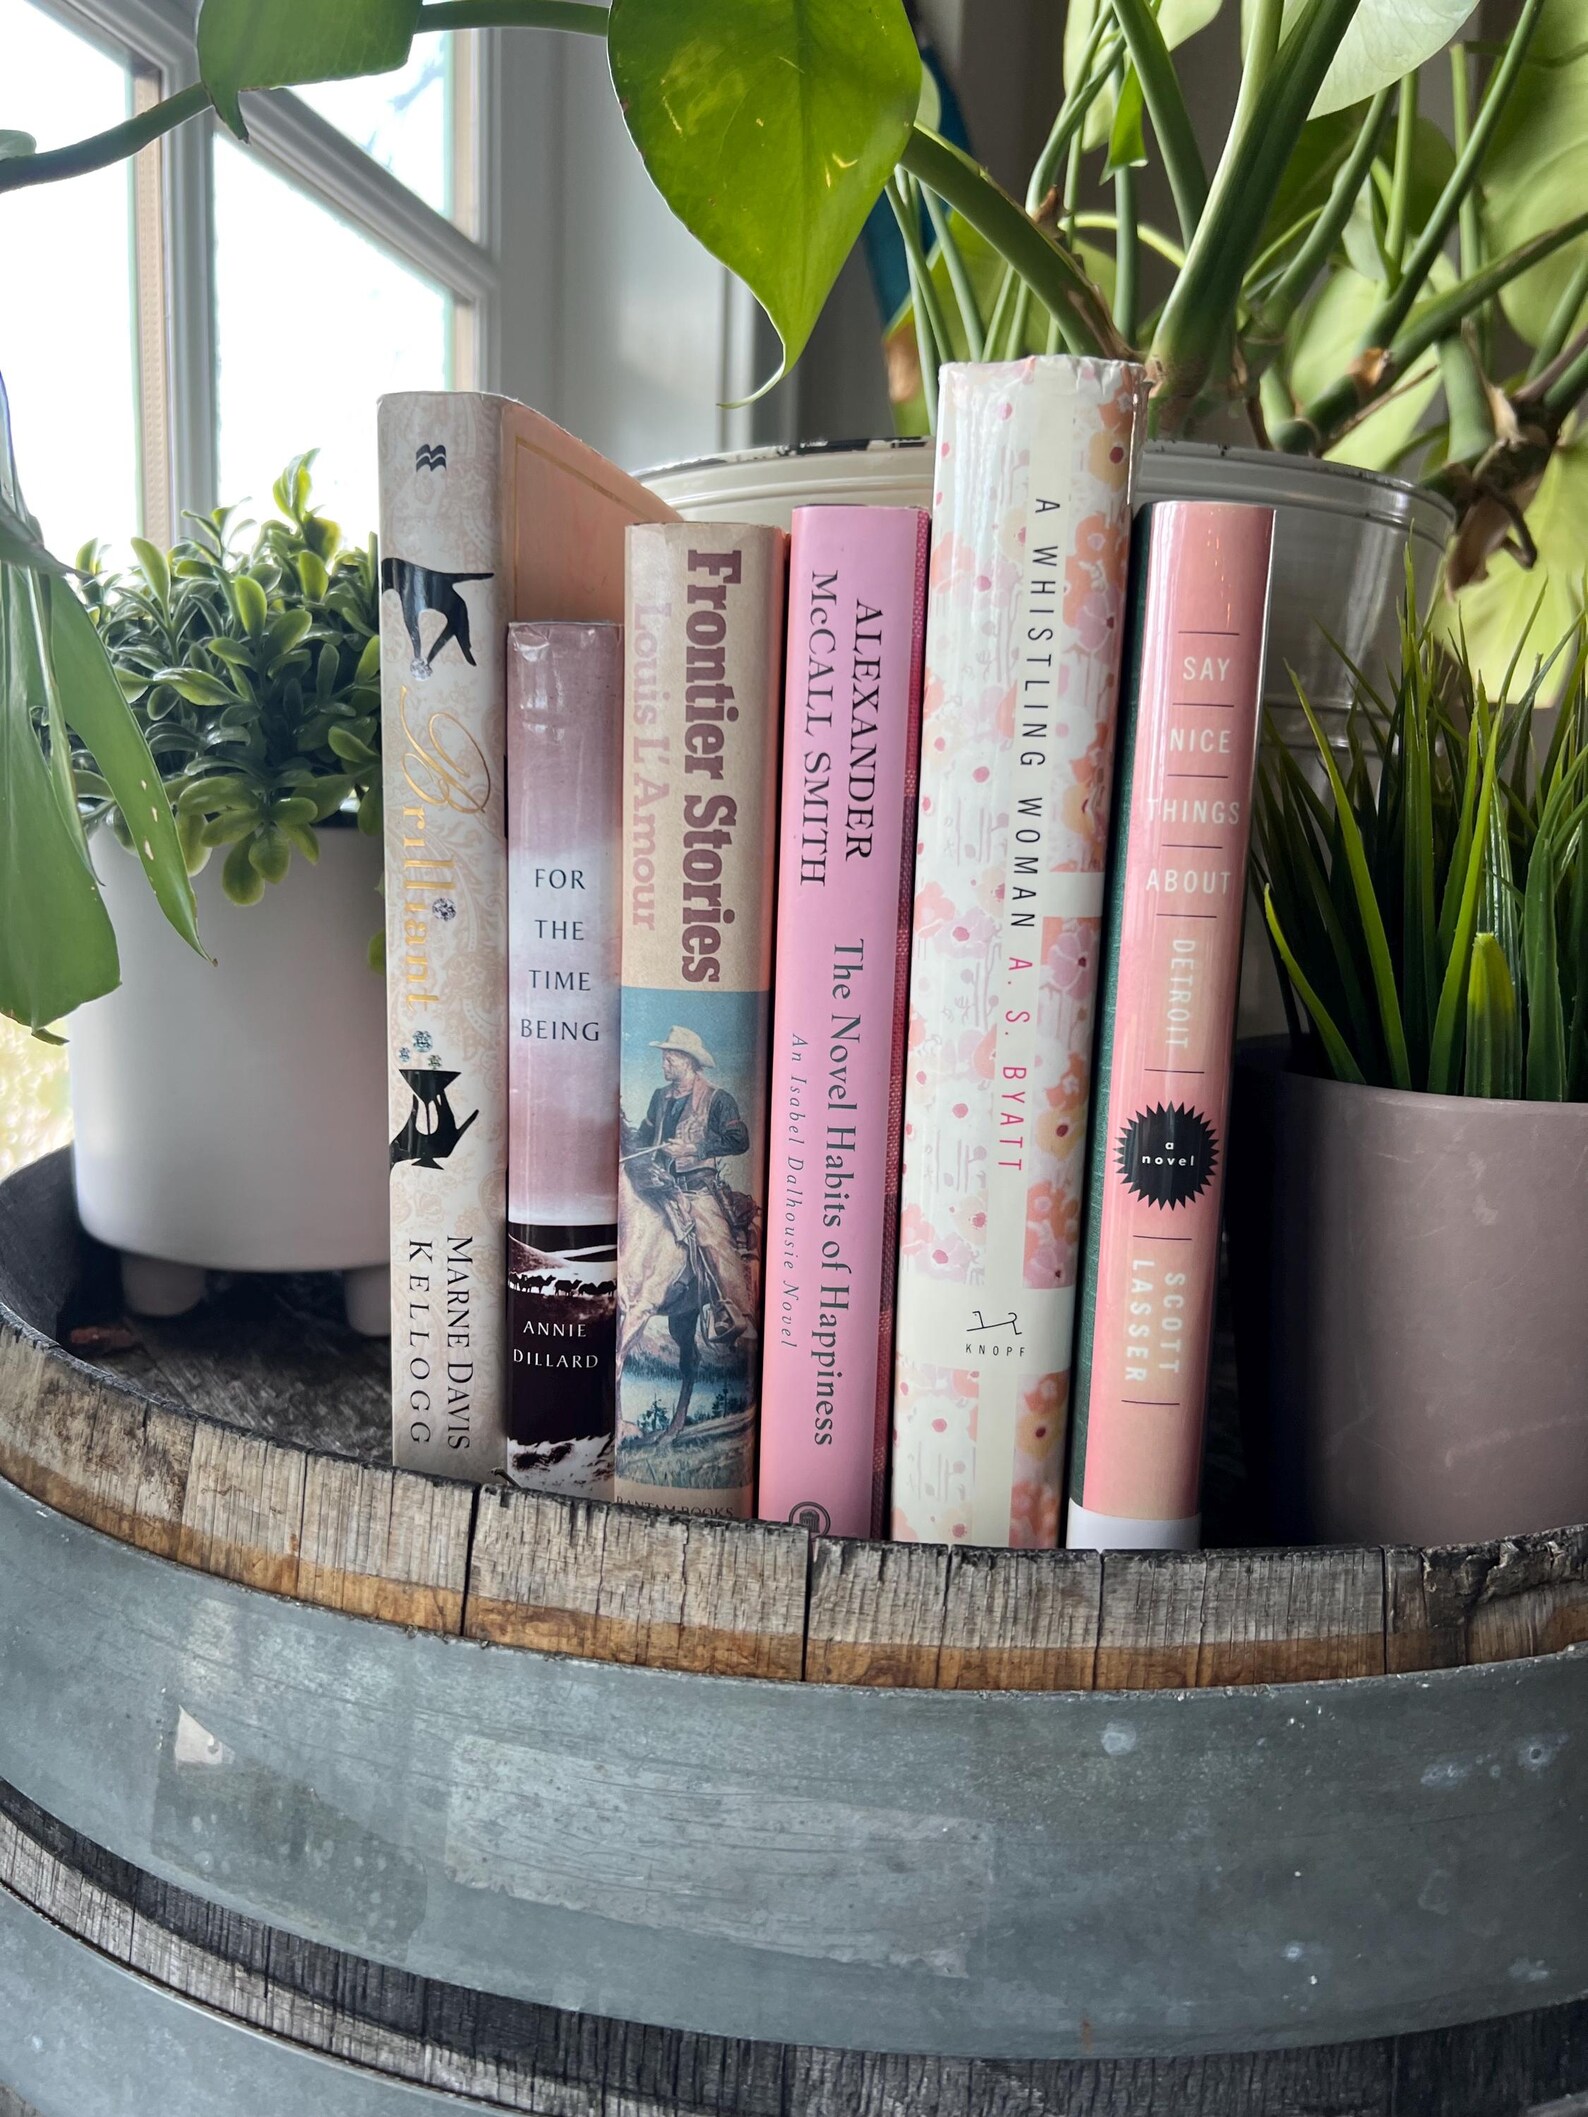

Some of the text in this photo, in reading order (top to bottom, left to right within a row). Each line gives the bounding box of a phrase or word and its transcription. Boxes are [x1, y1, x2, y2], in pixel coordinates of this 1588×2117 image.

[632, 602, 673, 726] Louis
[1010, 498, 1060, 928] A WHISTLING WOMAN
[1183, 657, 1231, 682] SAY
[681, 549, 742, 983] Frontier Stories
[800, 570, 839, 887] McCALL SMITH
[845, 599, 885, 861] ALEXANDER
[1169, 728, 1232, 754] NICE
[400, 685, 491, 1012] Brilliant
[1147, 799, 1241, 826] THINGS
[534, 919, 585, 941] THE
[535, 868, 586, 890] FOR
[1145, 869, 1232, 895] ABOUT
[520, 1018, 600, 1042] BEING
[528, 969, 592, 991] TIME
[1165, 939, 1196, 1049] DETROIT
[998, 956, 1033, 1171] A. S. BYATT
[781, 1033, 809, 1348] An Isabel Dalhousie Novel
[811, 938, 864, 1446] The Novel Habits of Happiness
[1142, 1153, 1195, 1167] novel
[1165, 1140, 1174, 1150] a
[409, 1240, 433, 1444] KELLOGG
[447, 1236, 474, 1450] MARNE DAVIS
[513, 1348, 599, 1369] DILLARD
[523, 1320, 587, 1338] ANNIE
[965, 1343, 1026, 1357] KNOPF
[1124, 1259, 1155, 1382] LASSER
[1159, 1272, 1186, 1374] SCOTT
